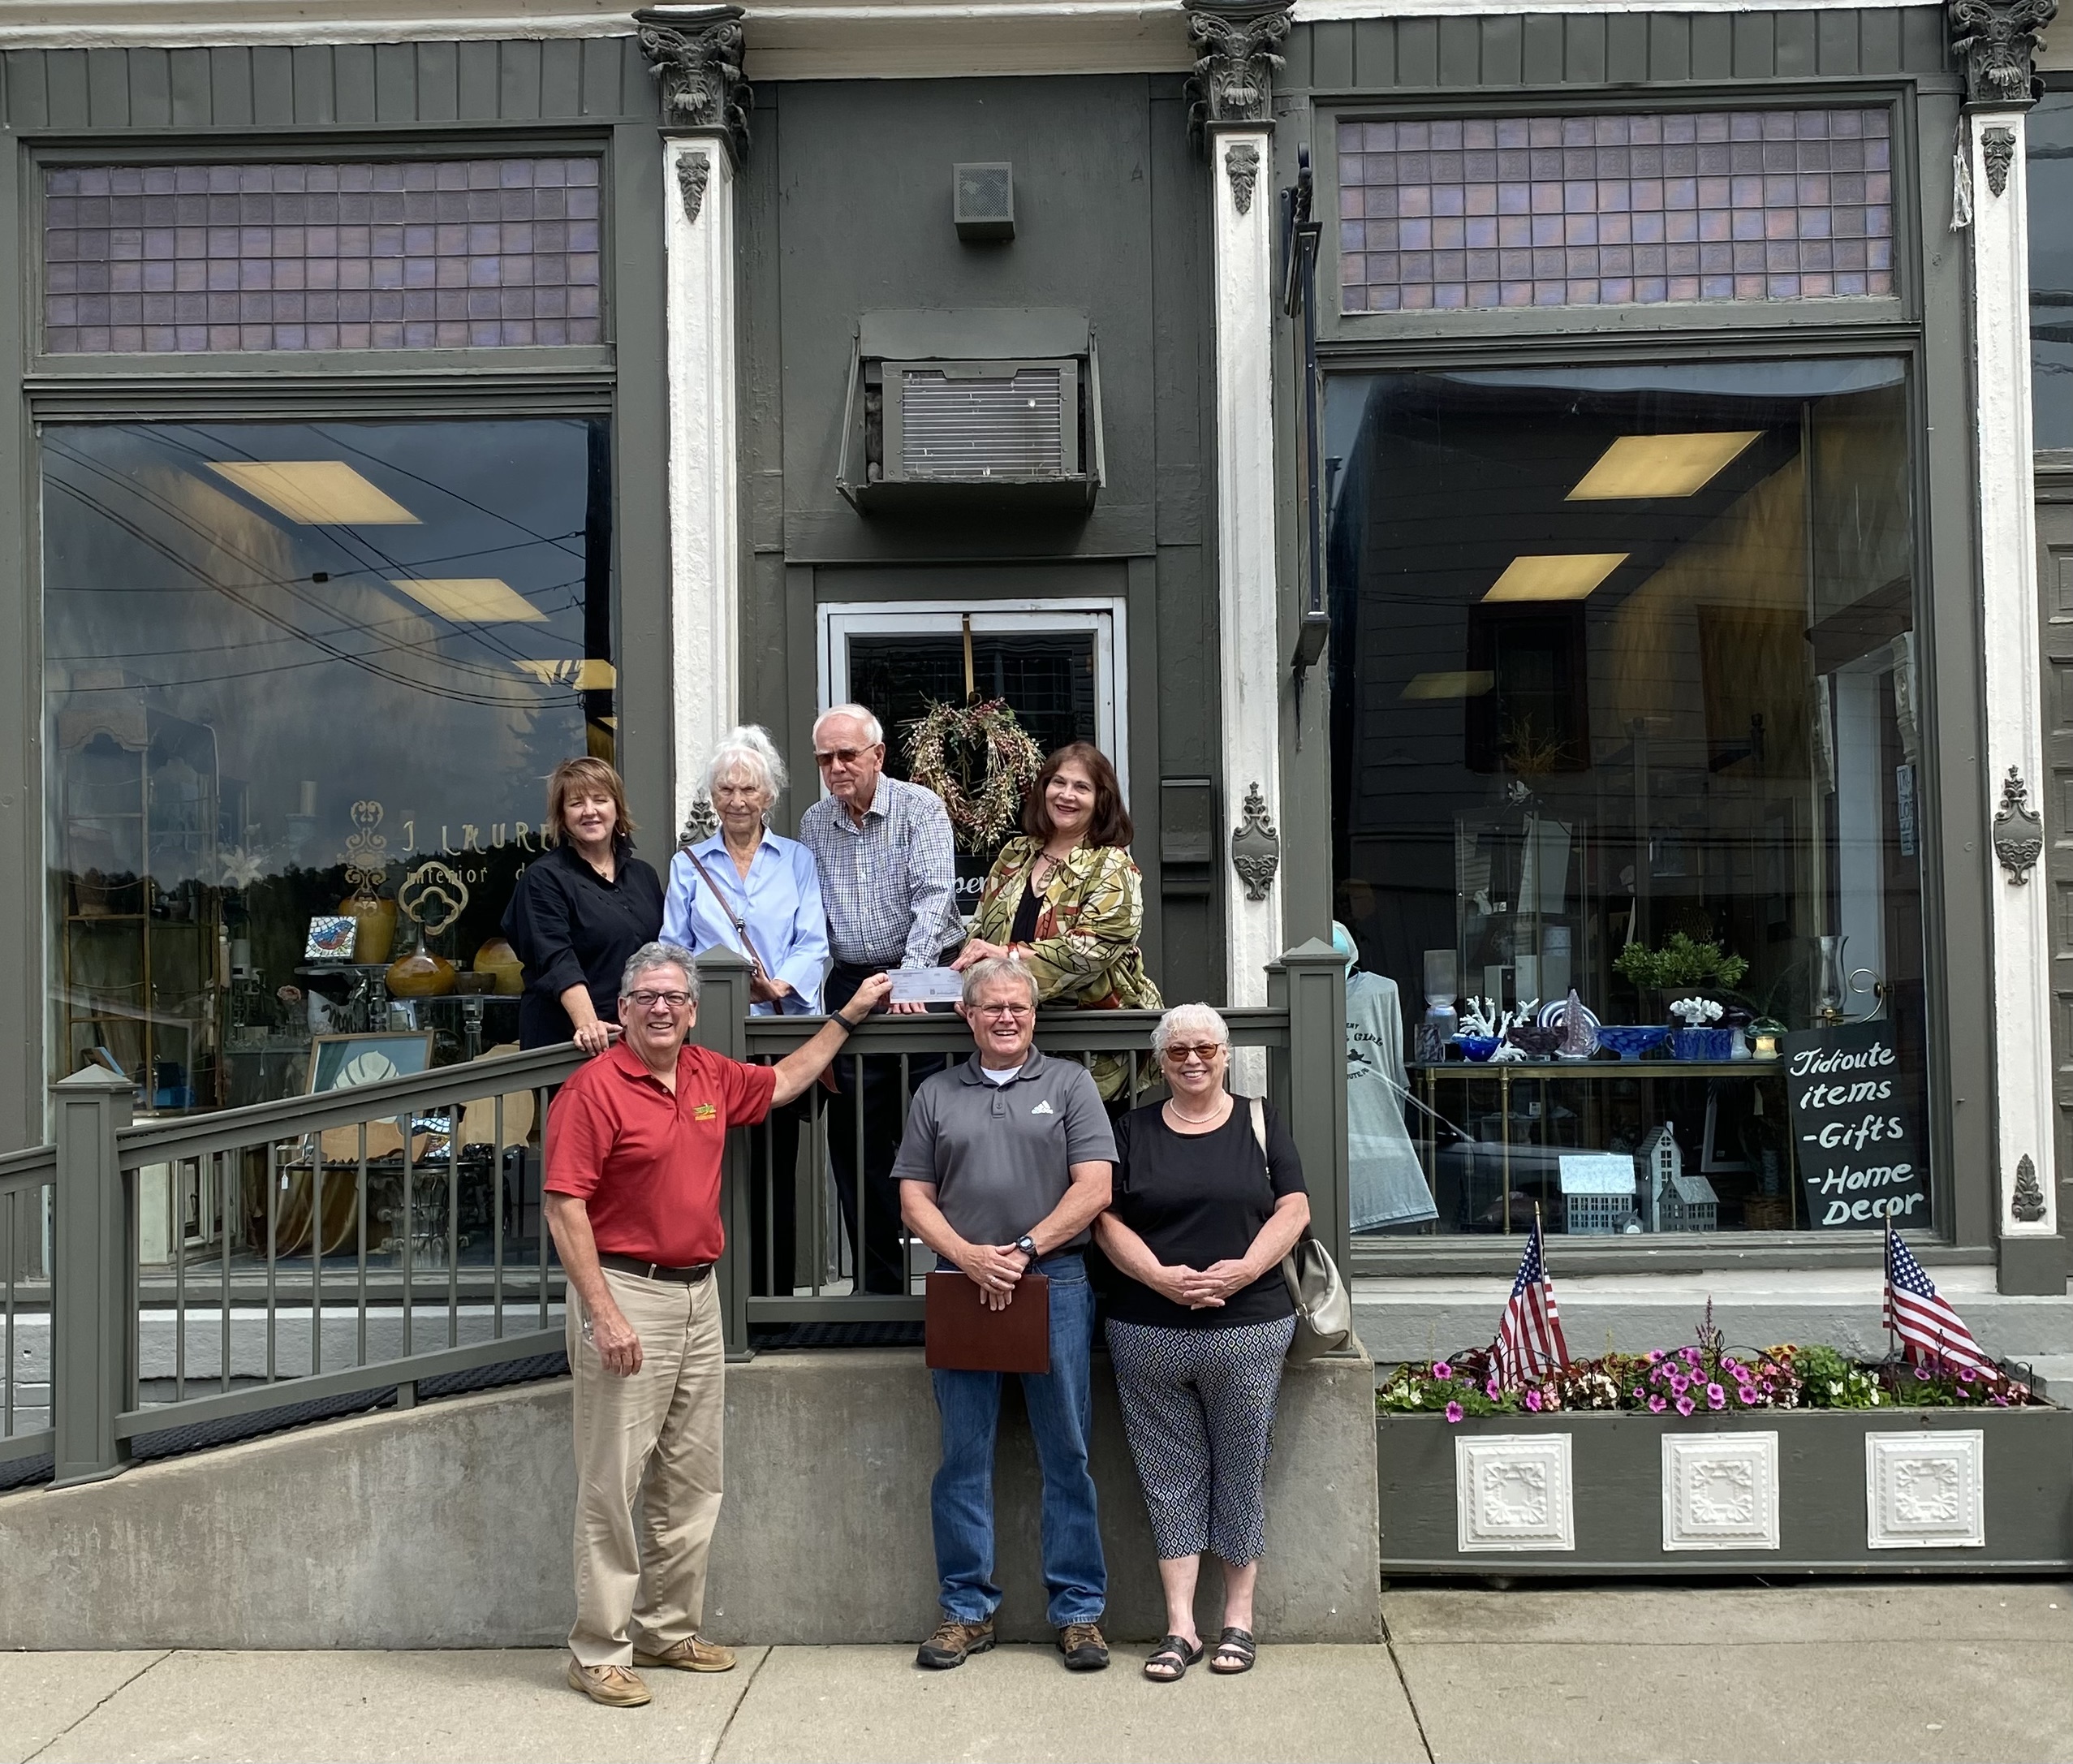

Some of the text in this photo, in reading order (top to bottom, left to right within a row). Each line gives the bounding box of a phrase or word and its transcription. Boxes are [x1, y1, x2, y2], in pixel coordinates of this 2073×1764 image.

[442, 821, 552, 856] LAURE
[407, 865, 488, 884] interior
[1354, 1033, 1383, 1047] GIRL
[1790, 1042, 1896, 1076] Tidioute
[1799, 1080, 1892, 1109] items
[1822, 1192, 1925, 1225] Decor
